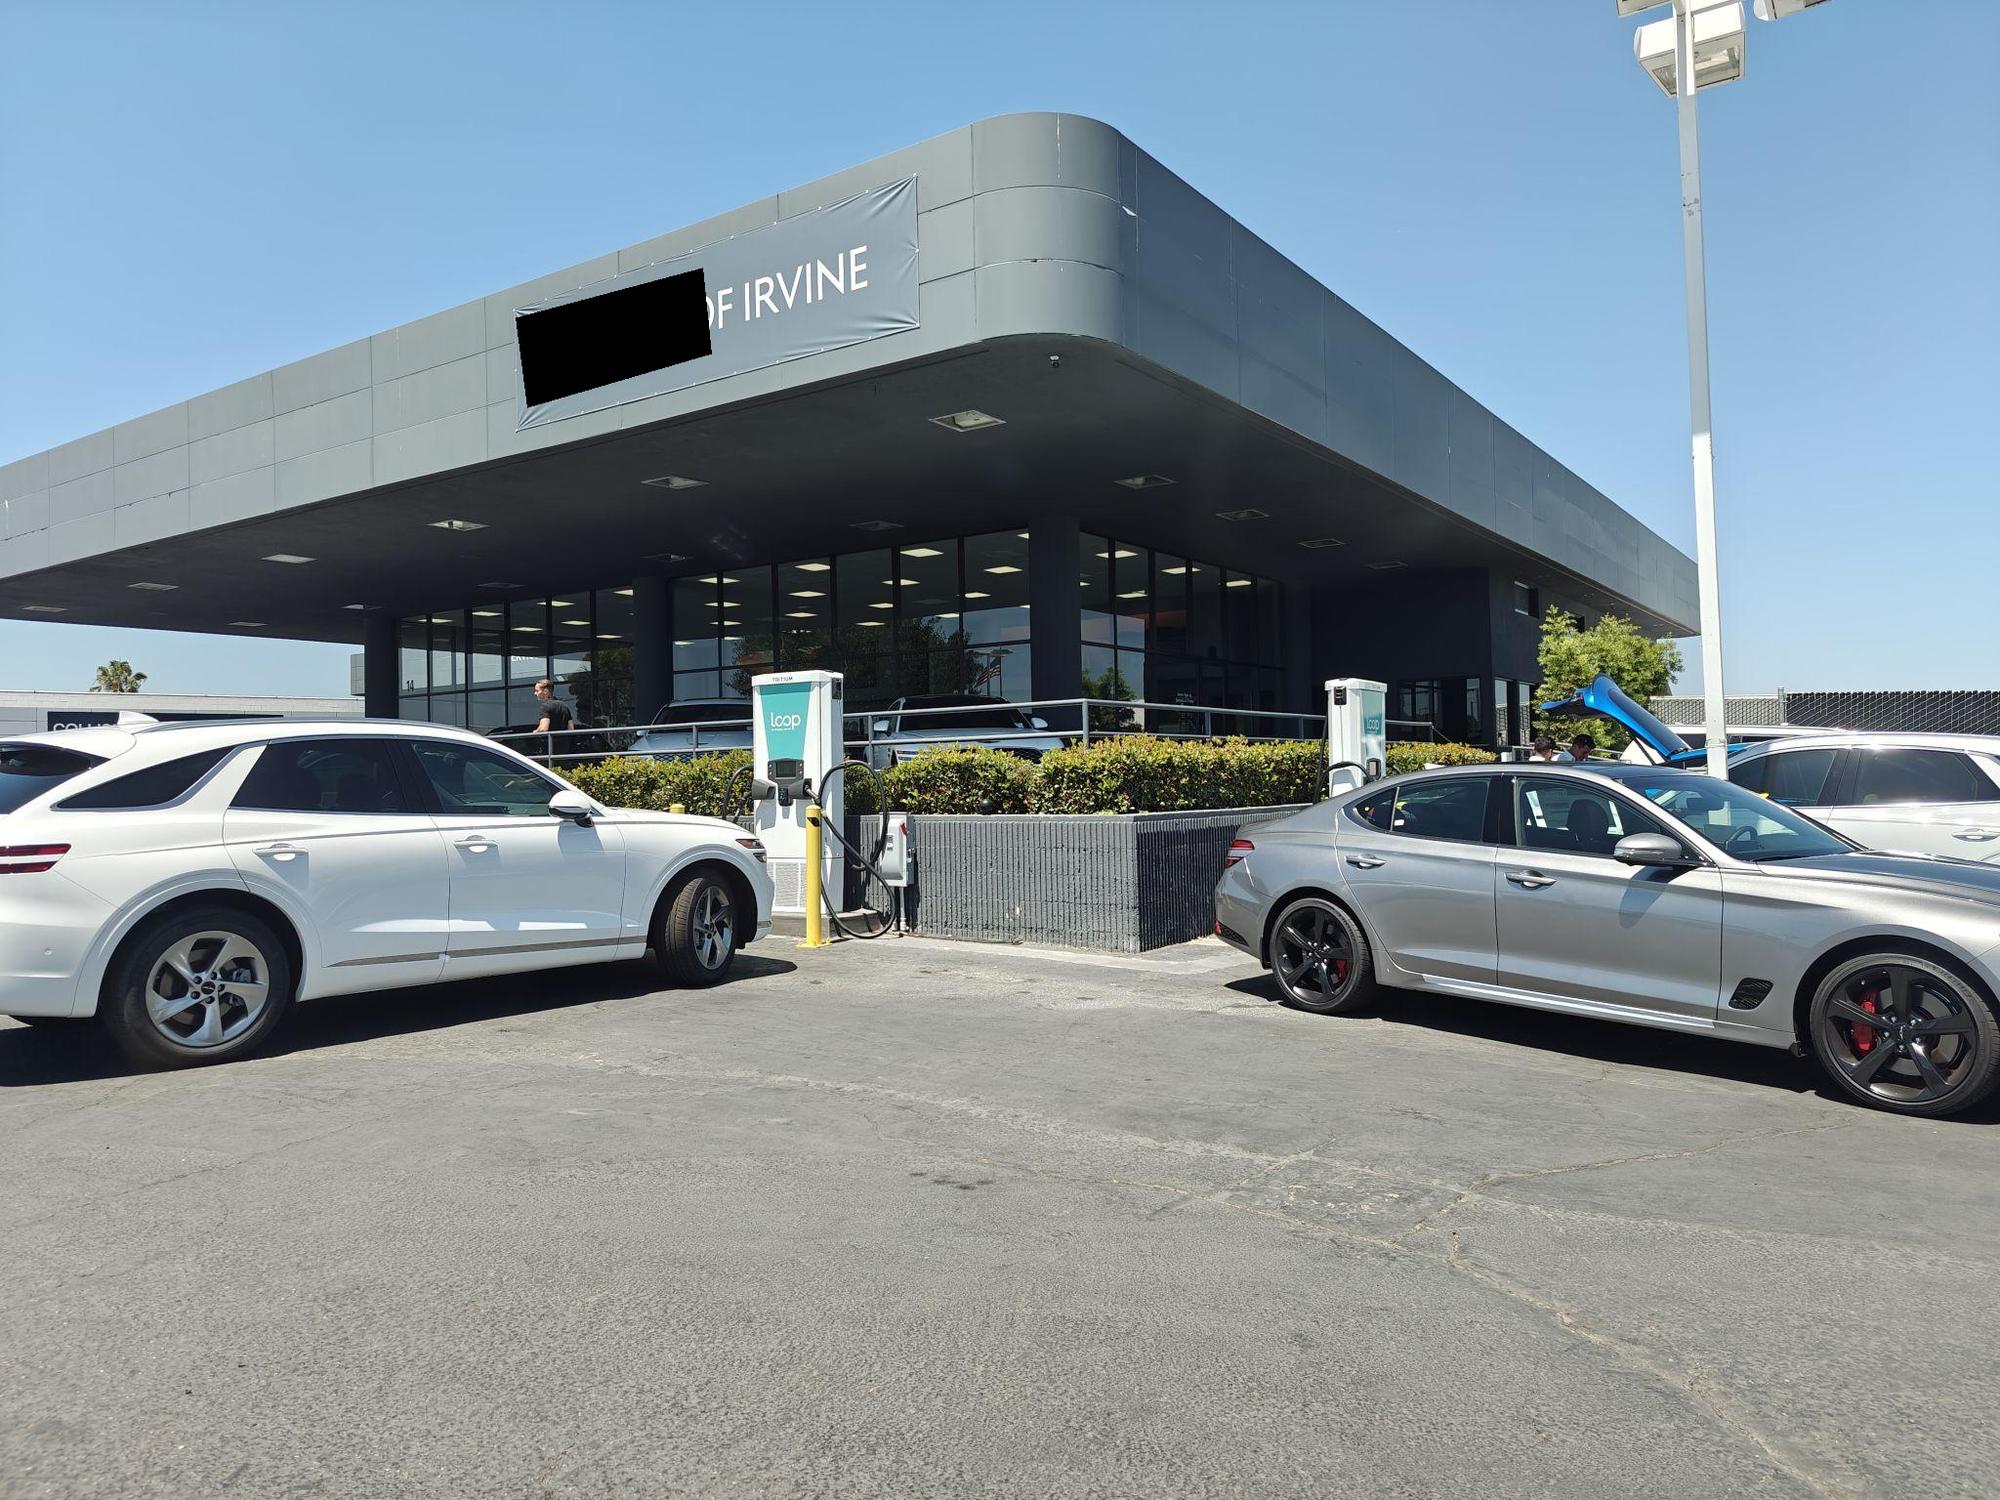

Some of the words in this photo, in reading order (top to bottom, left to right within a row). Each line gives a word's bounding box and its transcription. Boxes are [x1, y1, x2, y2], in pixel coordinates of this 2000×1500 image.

[744, 245, 868, 322] IRVINE
[406, 679, 414, 693] 14
[770, 711, 801, 730] loop
